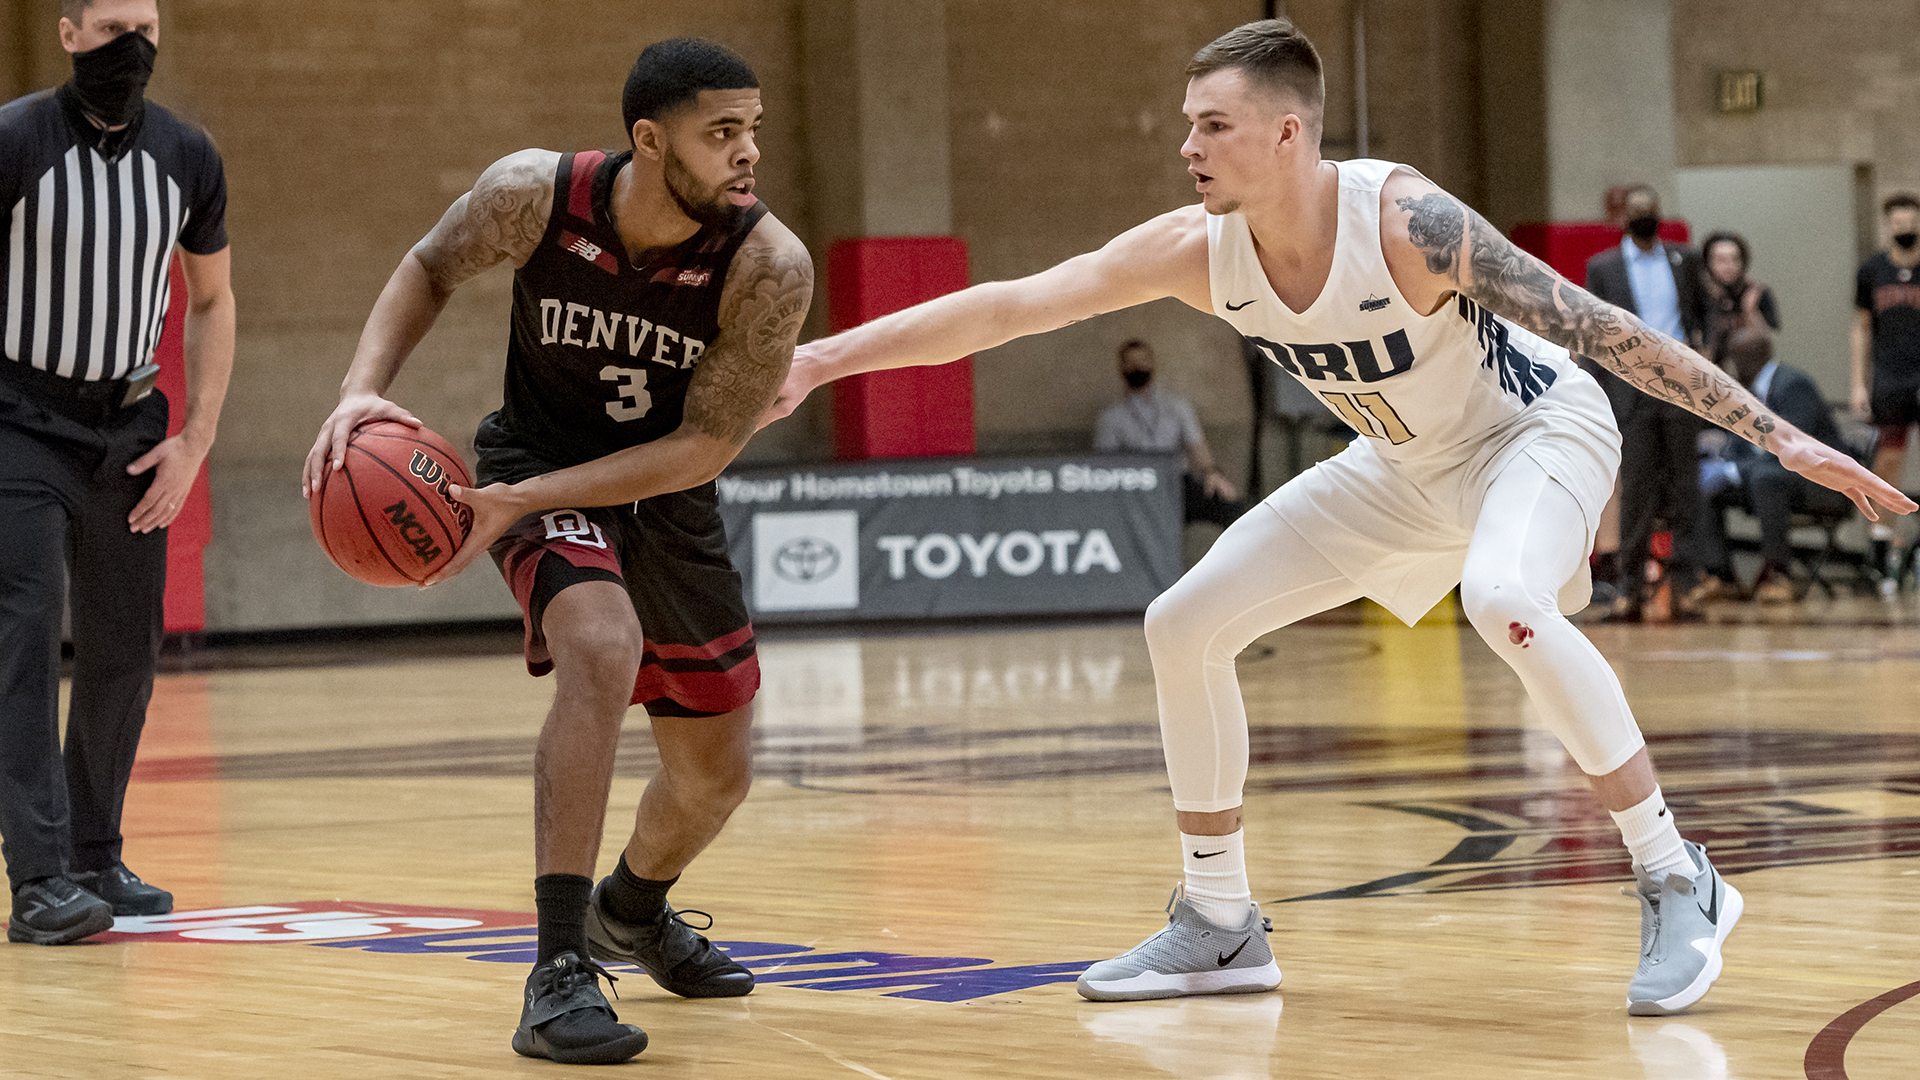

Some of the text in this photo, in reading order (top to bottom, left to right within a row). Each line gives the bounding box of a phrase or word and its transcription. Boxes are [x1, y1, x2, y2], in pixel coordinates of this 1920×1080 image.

[540, 298, 706, 369] DENVER
[600, 365, 652, 423] 3
[1319, 390, 1418, 446] 11
[408, 448, 472, 536] Wion
[719, 463, 1157, 503] Your Hometown Toyota Stores
[383, 500, 443, 565] NCAA
[876, 528, 1123, 580] TOYOTA
